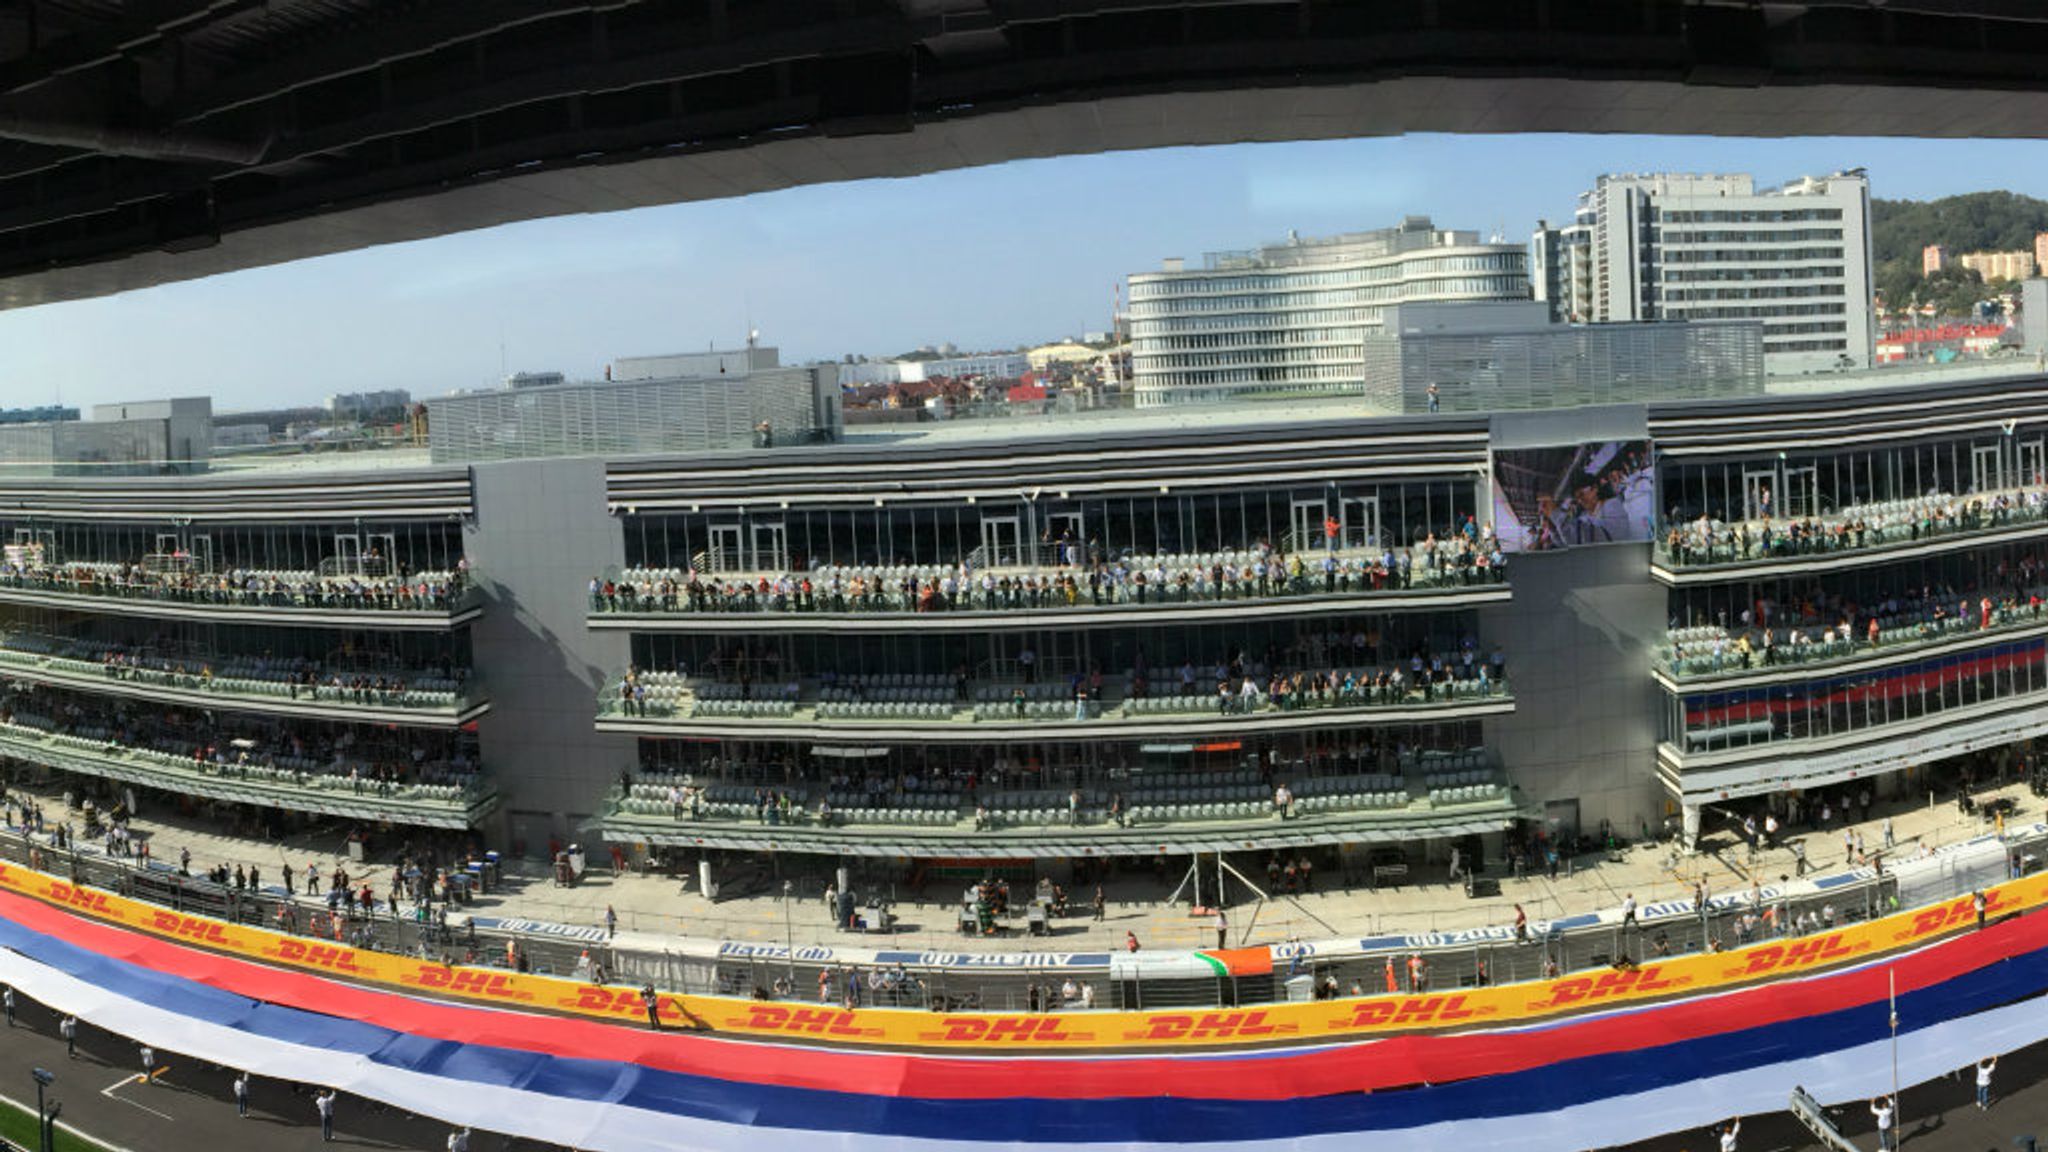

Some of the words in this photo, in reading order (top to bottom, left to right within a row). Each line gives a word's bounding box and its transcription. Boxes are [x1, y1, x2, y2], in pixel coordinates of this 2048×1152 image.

[51, 883, 110, 914] DHL
[1914, 891, 2005, 935] DHL
[154, 912, 227, 944] DHL
[278, 940, 359, 972] DHL
[966, 953, 1074, 966] Allianz
[1746, 935, 1851, 973] DHL
[419, 966, 513, 997] DHL
[1550, 968, 1671, 1006] DHL
[576, 988, 679, 1019] DHL
[1352, 997, 1472, 1026] DHL
[749, 1007, 862, 1036] DHL
[943, 1018, 1068, 1041] DHL
[1147, 1012, 1274, 1039] DHL
